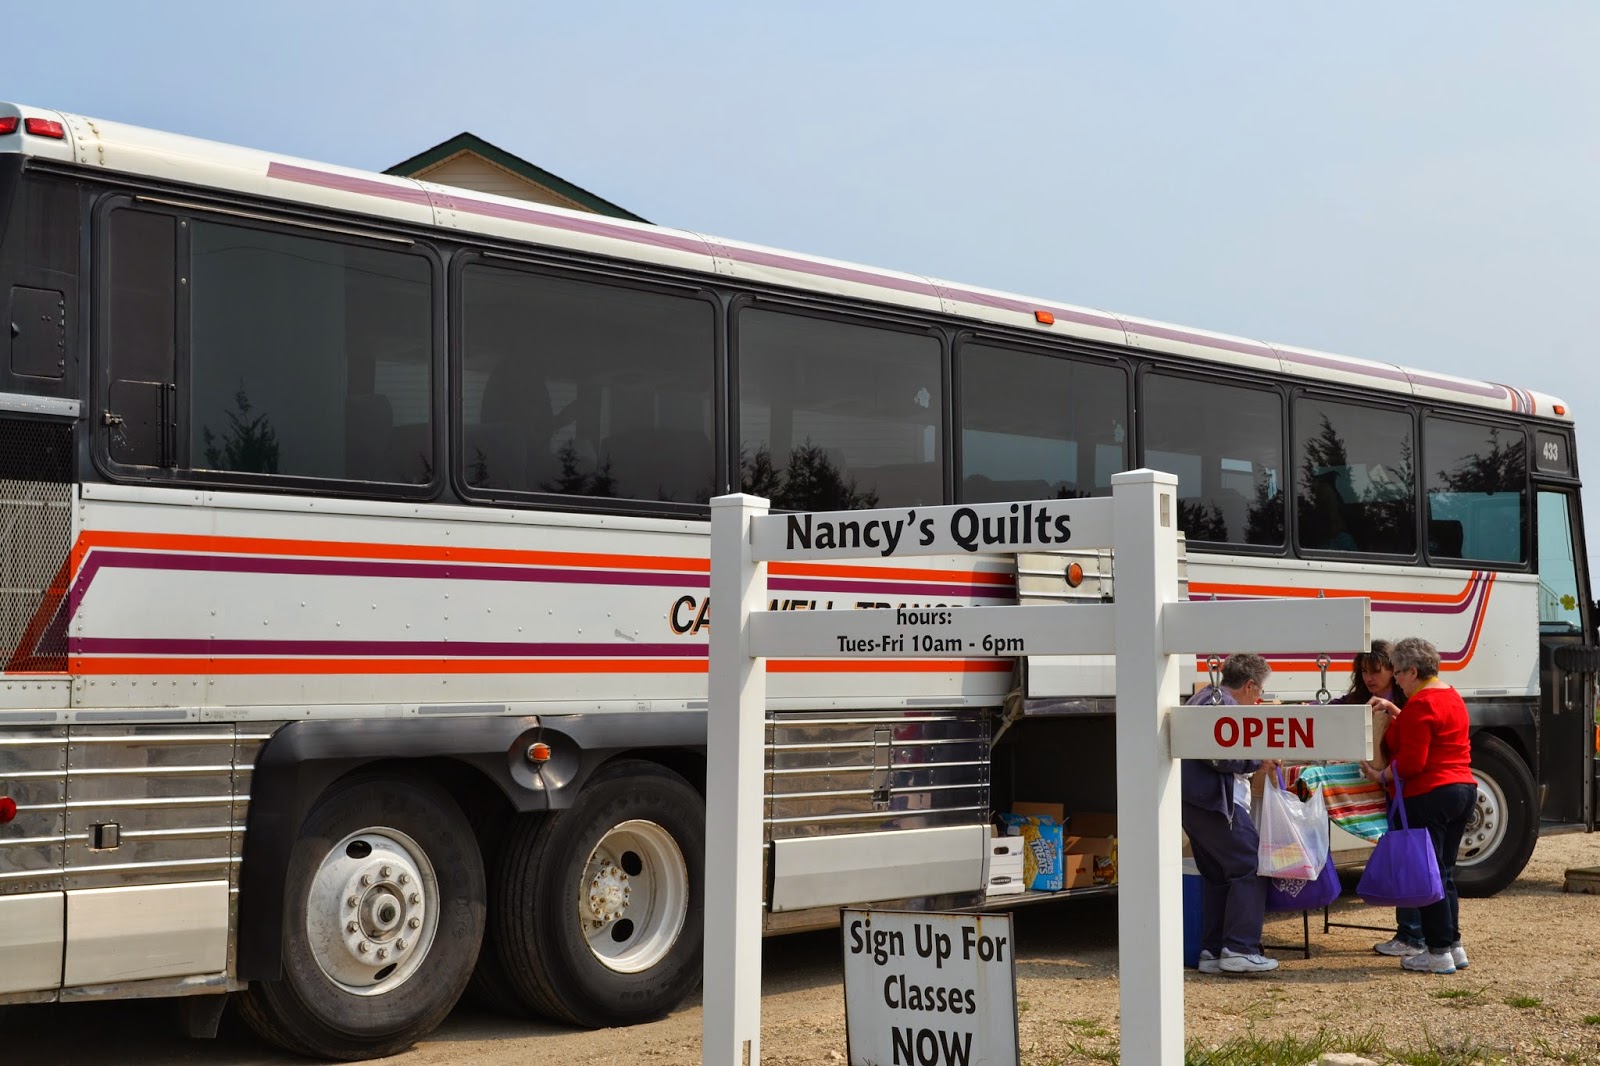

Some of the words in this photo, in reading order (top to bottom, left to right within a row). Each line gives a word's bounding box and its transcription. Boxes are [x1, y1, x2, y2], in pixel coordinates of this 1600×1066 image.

[1543, 442, 1558, 461] 433
[786, 509, 936, 557] Nancy's
[950, 503, 1072, 552] Quilts
[896, 608, 952, 626] hours:
[837, 634, 904, 652] Tues-Fri
[912, 634, 962, 652] 10am
[982, 634, 1025, 655] 6pm
[1213, 716, 1314, 748] OPEN
[1030, 837, 1048, 875] TREATS
[850, 919, 905, 966] Sign
[914, 924, 951, 969] Up
[961, 926, 1007, 962] For
[884, 974, 976, 1015] Classes
[891, 1026, 973, 1066] NOW
